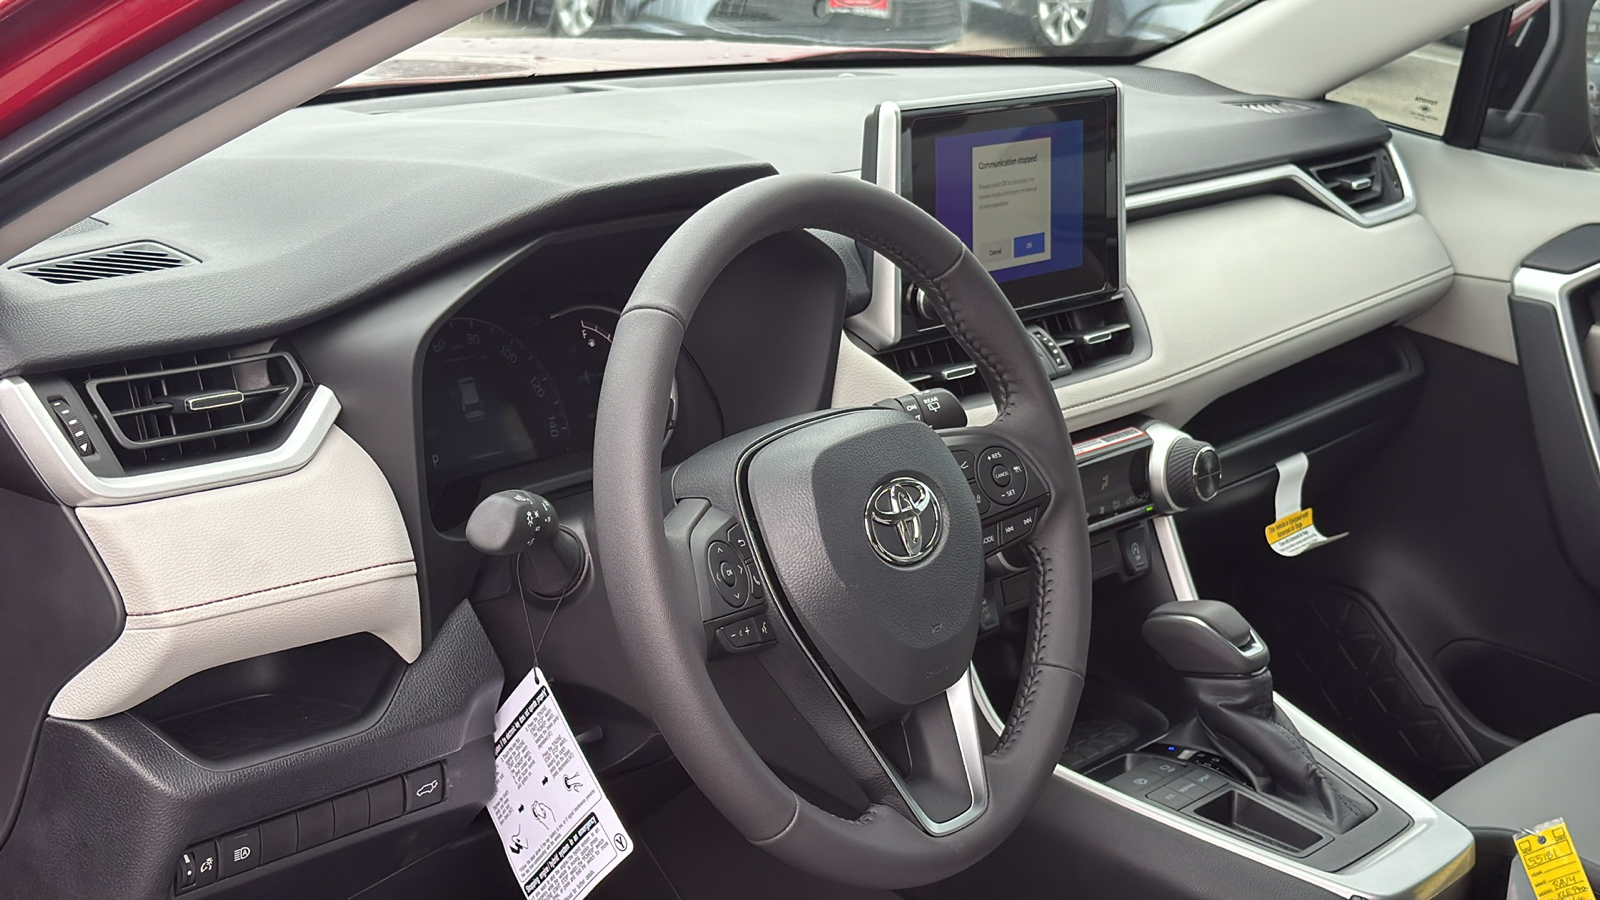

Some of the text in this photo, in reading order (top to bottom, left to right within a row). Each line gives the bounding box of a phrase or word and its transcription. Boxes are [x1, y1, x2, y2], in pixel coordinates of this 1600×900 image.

[979, 154, 1037, 169] Communication stopped
[466, 333, 480, 345] 80
[500, 346, 519, 364] 100
[530, 376, 545, 398] 120
[907, 404, 917, 412] ON
[547, 415, 559, 438] 140
[432, 454, 439, 466] P
[1006, 489, 1016, 497] SET
[526, 876, 541, 895] Stopping
